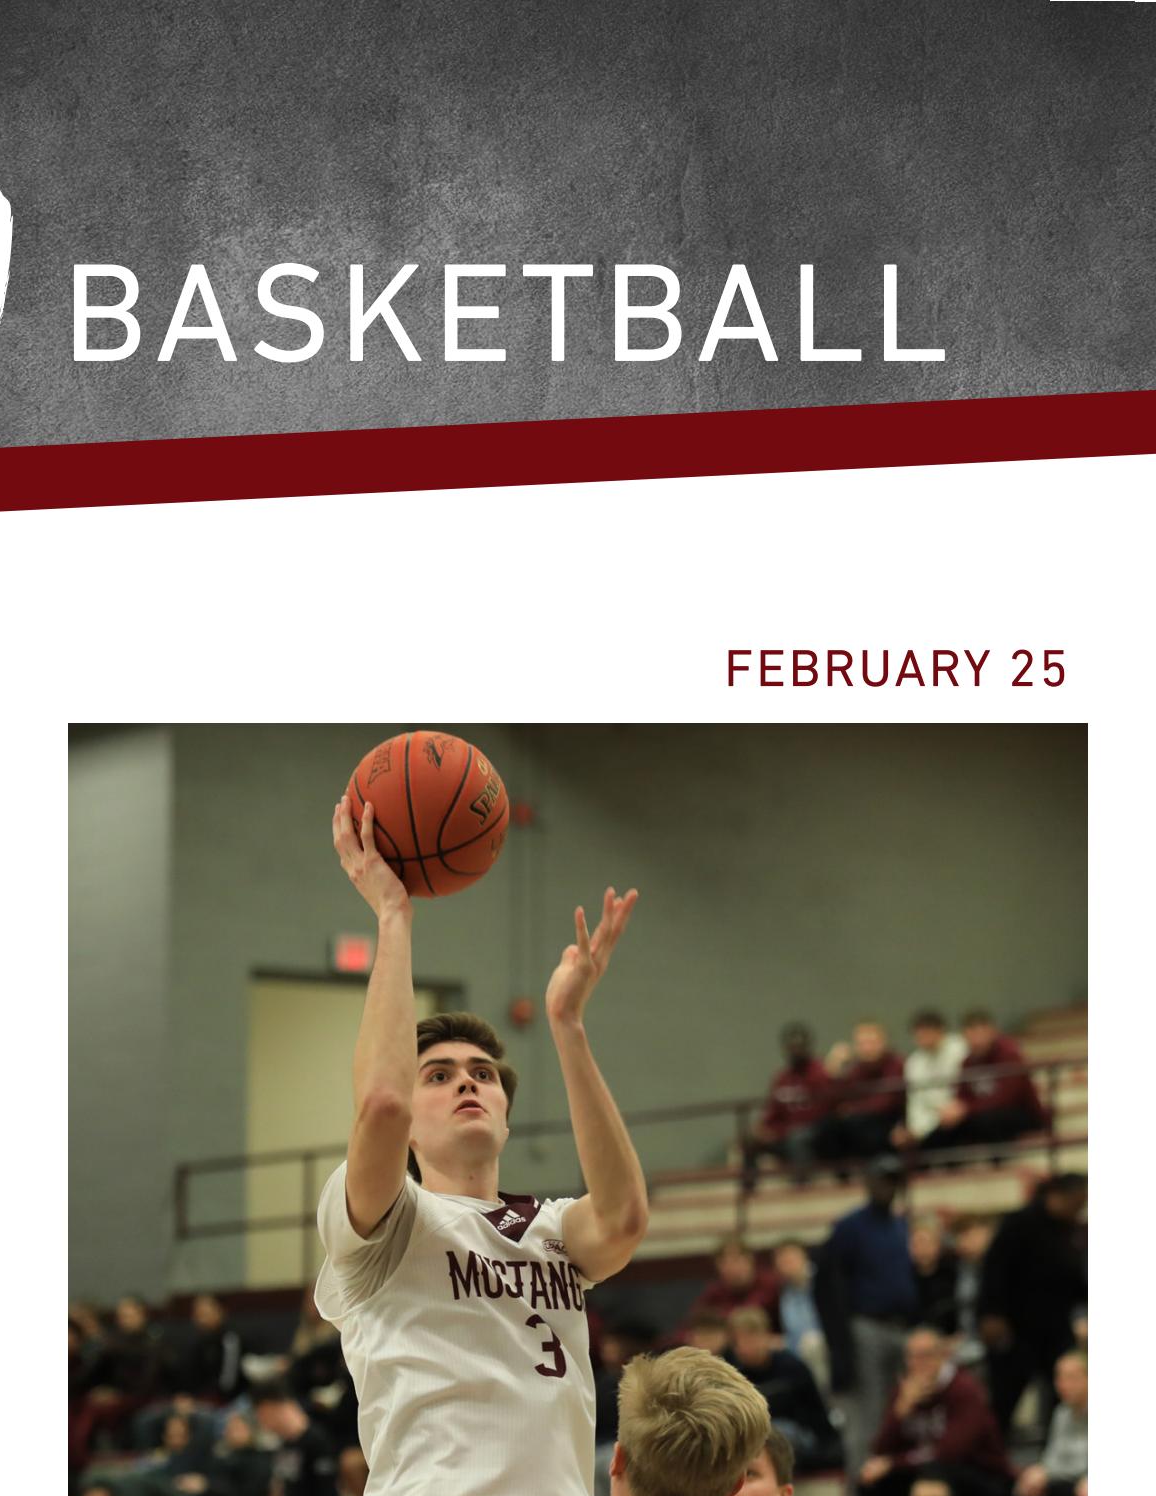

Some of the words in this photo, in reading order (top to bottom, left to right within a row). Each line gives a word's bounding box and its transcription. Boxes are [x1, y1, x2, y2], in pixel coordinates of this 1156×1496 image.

[72, 262, 947, 364] BASKETBALL
[728, 649, 991, 688] FEBRUARY
[1011, 649, 1065, 688] 25
[525, 1313, 567, 1379] 3
